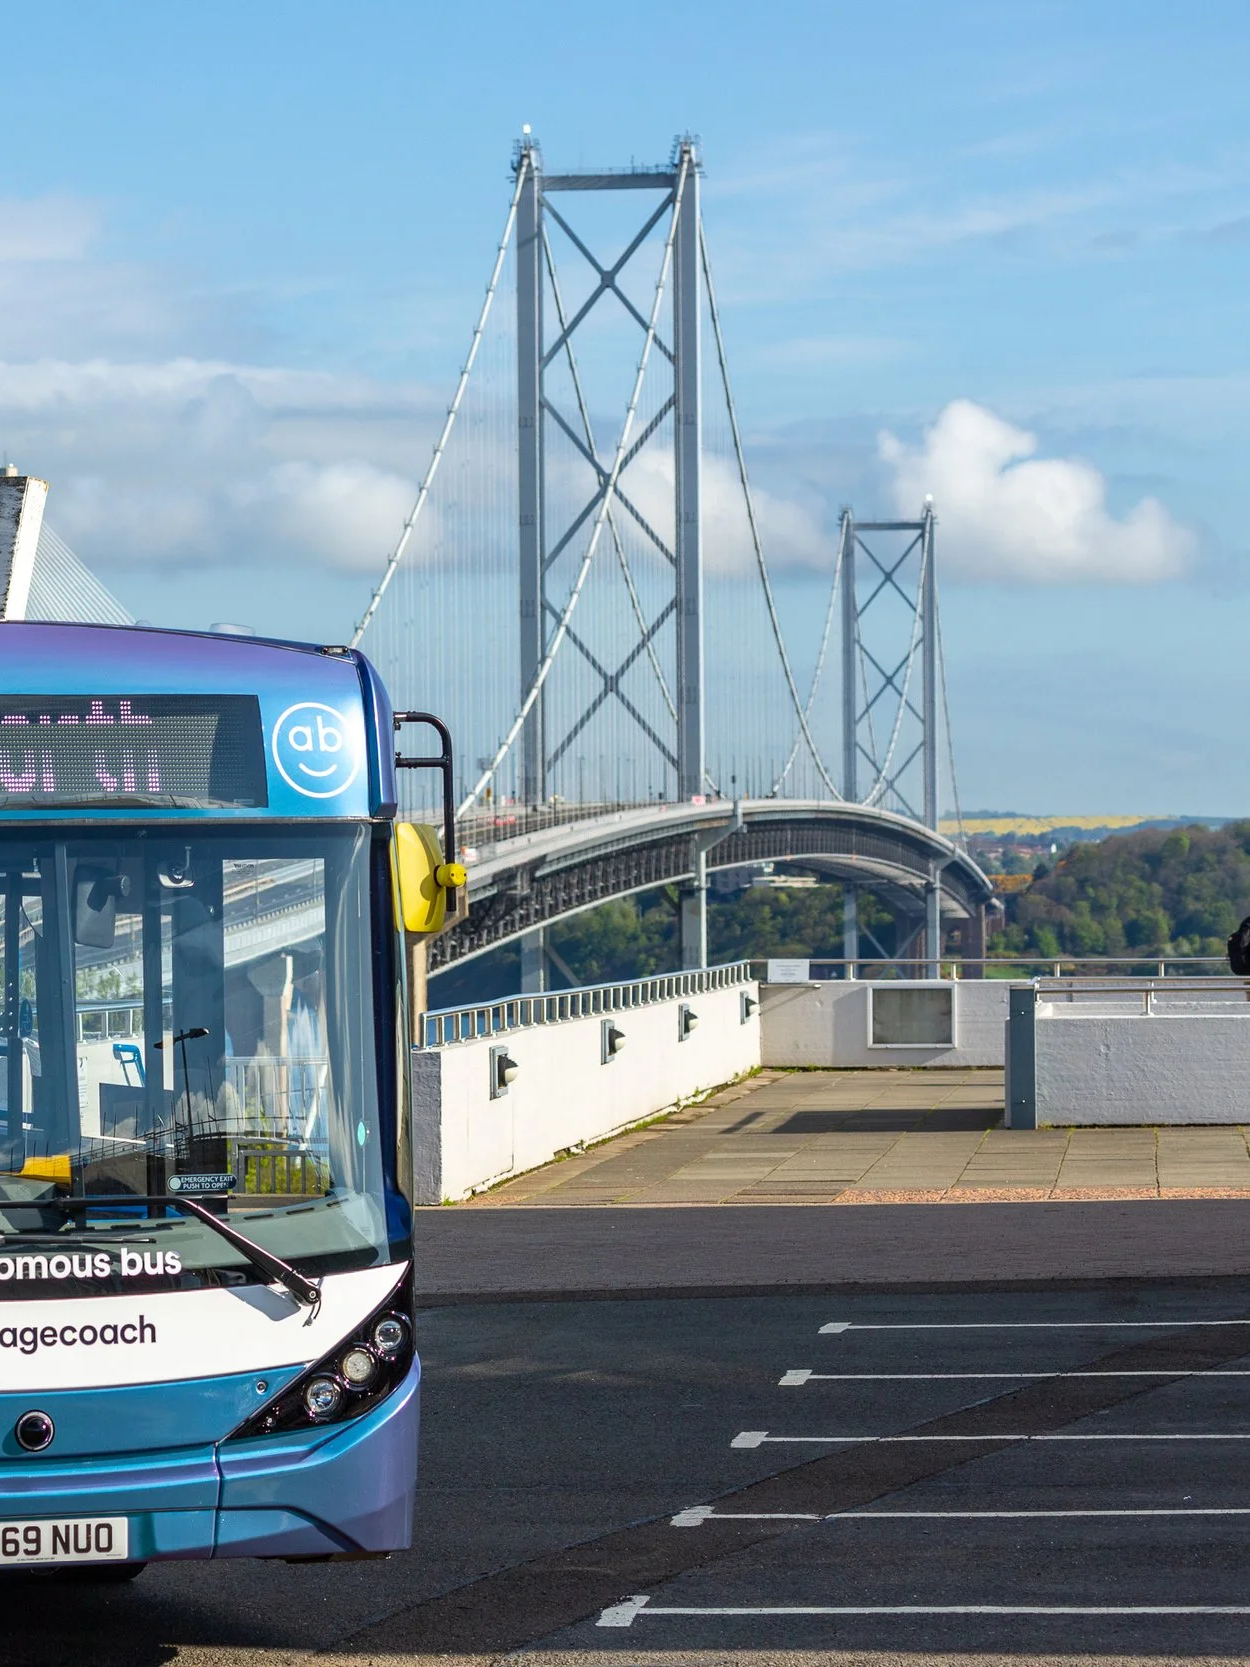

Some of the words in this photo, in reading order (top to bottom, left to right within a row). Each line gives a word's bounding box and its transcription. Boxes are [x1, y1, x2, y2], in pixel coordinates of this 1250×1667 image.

[288, 715, 343, 753] ab
[183, 1182, 201, 1190] PUSH
[120, 1247, 182, 1277] bus
[52, 1522, 113, 1555] NUO
